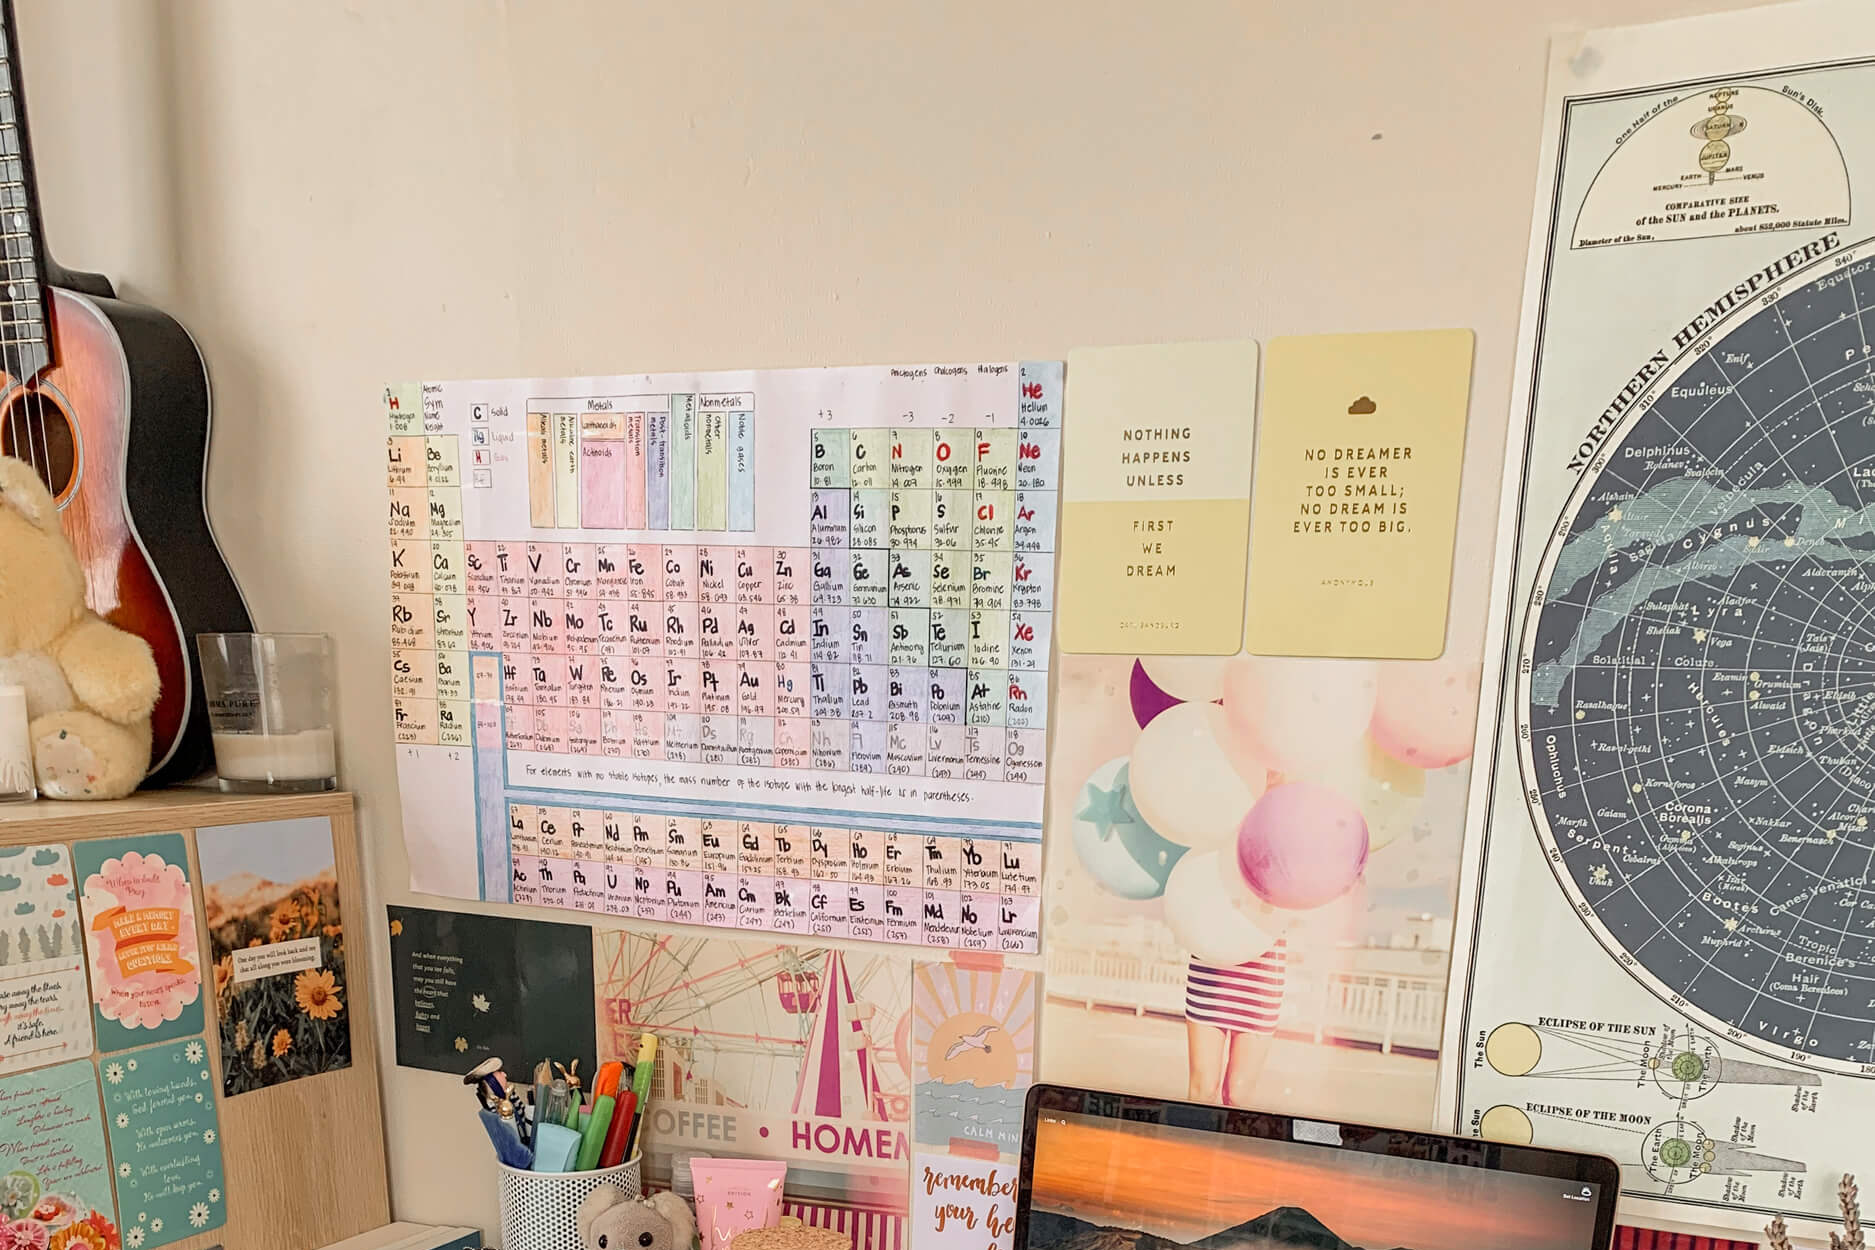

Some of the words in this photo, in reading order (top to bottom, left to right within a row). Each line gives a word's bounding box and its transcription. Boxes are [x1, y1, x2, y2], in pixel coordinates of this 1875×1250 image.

[1782, 85, 1805, 101] Sun's
[1616, 128, 1632, 145] One
[1633, 111, 1650, 127] Half
[1652, 103, 1662, 114] of
[1663, 96, 1679, 108] the
[1665, 198, 1726, 211] COMPARATIVE
[1730, 196, 1749, 206] SIZE
[1636, 216, 1649, 226] of
[1649, 215, 1664, 225] the
[1666, 213, 1686, 223] SUN
[1690, 211, 1707, 221] and
[1710, 209, 1725, 220] the
[1728, 204, 1780, 218] PLANETS.
[1735, 224, 1758, 233] about
[1792, 219, 1821, 228] Statute
[1613, 236, 1622, 245] of
[1623, 235, 1635, 244] the
[1566, 349, 1670, 476] NORTHERN
[1672, 231, 1841, 350] HEMISPHERE
[1021, 382, 1044, 399] He
[1671, 383, 1734, 398] Equuleus
[388, 396, 400, 410] H
[1123, 427, 1192, 442] NOTHING
[387, 448, 402, 462] Li
[814, 444, 825, 459] B
[855, 444, 867, 460] C
[891, 444, 903, 460] N
[936, 443, 951, 461] O
[977, 443, 991, 462] F
[1019, 443, 1041, 460] Ne
[1122, 450, 1191, 465] HAPPENS
[1305, 448, 1327, 461] NO
[1334, 447, 1413, 461] DREAMER
[1625, 446, 1690, 459] Delphinus
[1126, 473, 1185, 487] UNLESS
[1325, 466, 1340, 479] IS
[1348, 466, 1388, 479] EVER
[1306, 484, 1337, 497] TOO
[1344, 484, 1405, 498] SMALL;
[390, 502, 411, 518] Na
[811, 505, 828, 521] Al
[977, 503, 994, 521] Cl
[1017, 506, 1035, 522] Ar
[1300, 502, 1322, 515] NO
[1329, 502, 1386, 515] DREAM
[1392, 501, 1408, 515] IS
[1133, 520, 1175, 533] FIRST
[1293, 521, 1333, 534] EVER
[1340, 520, 1372, 533] TOO
[1379, 520, 1413, 534] BIG.
[1682, 517, 1771, 550] Cygnus
[1142, 542, 1163, 555] WE
[433, 554, 450, 571] Ca
[598, 559, 616, 574] Mn
[628, 558, 645, 575] Fe
[700, 560, 714, 578] Ni
[776, 561, 793, 578] Zn
[973, 567, 992, 581] Br
[1014, 562, 1033, 582] Kr
[1126, 565, 1177, 578] DREAM
[533, 610, 553, 628] Nb
[737, 620, 755, 636] Ag
[1013, 622, 1034, 642] Xe
[1710, 637, 1733, 649] Vega
[740, 674, 760, 689] Au
[1008, 684, 1028, 702] Rn
[526, 765, 537, 776] For
[1665, 802, 1712, 814] Corona
[1659, 813, 1712, 825] Borealis
[775, 838, 791, 853] Tb
[1003, 853, 1020, 869] Lu
[1791, 973, 1820, 985] Hair
[1538, 1017, 1587, 1030] ECLIPSE
[1589, 1022, 1606, 1032] OF
[1608, 1023, 1631, 1034] THE
[1633, 1026, 1656, 1036] SUN
[1759, 1021, 1819, 1047] Virgo
[1476, 1030, 1487, 1049] Sun
[1474, 1050, 1484, 1069] The
[1640, 1040, 1651, 1067] Moon
[1637, 1068, 1647, 1088] The
[1526, 1102, 1573, 1117] ECLIPSE
[1575, 1109, 1592, 1119] OF
[1593, 1110, 1617, 1122] THE
[1619, 1113, 1653, 1125] MOON
[653, 1108, 737, 1142] OFFEE
[964, 1125, 994, 1138] CALM
[1652, 1128, 1663, 1153] Earth
[1649, 1154, 1659, 1173] The
[935, 1203, 978, 1232] your
